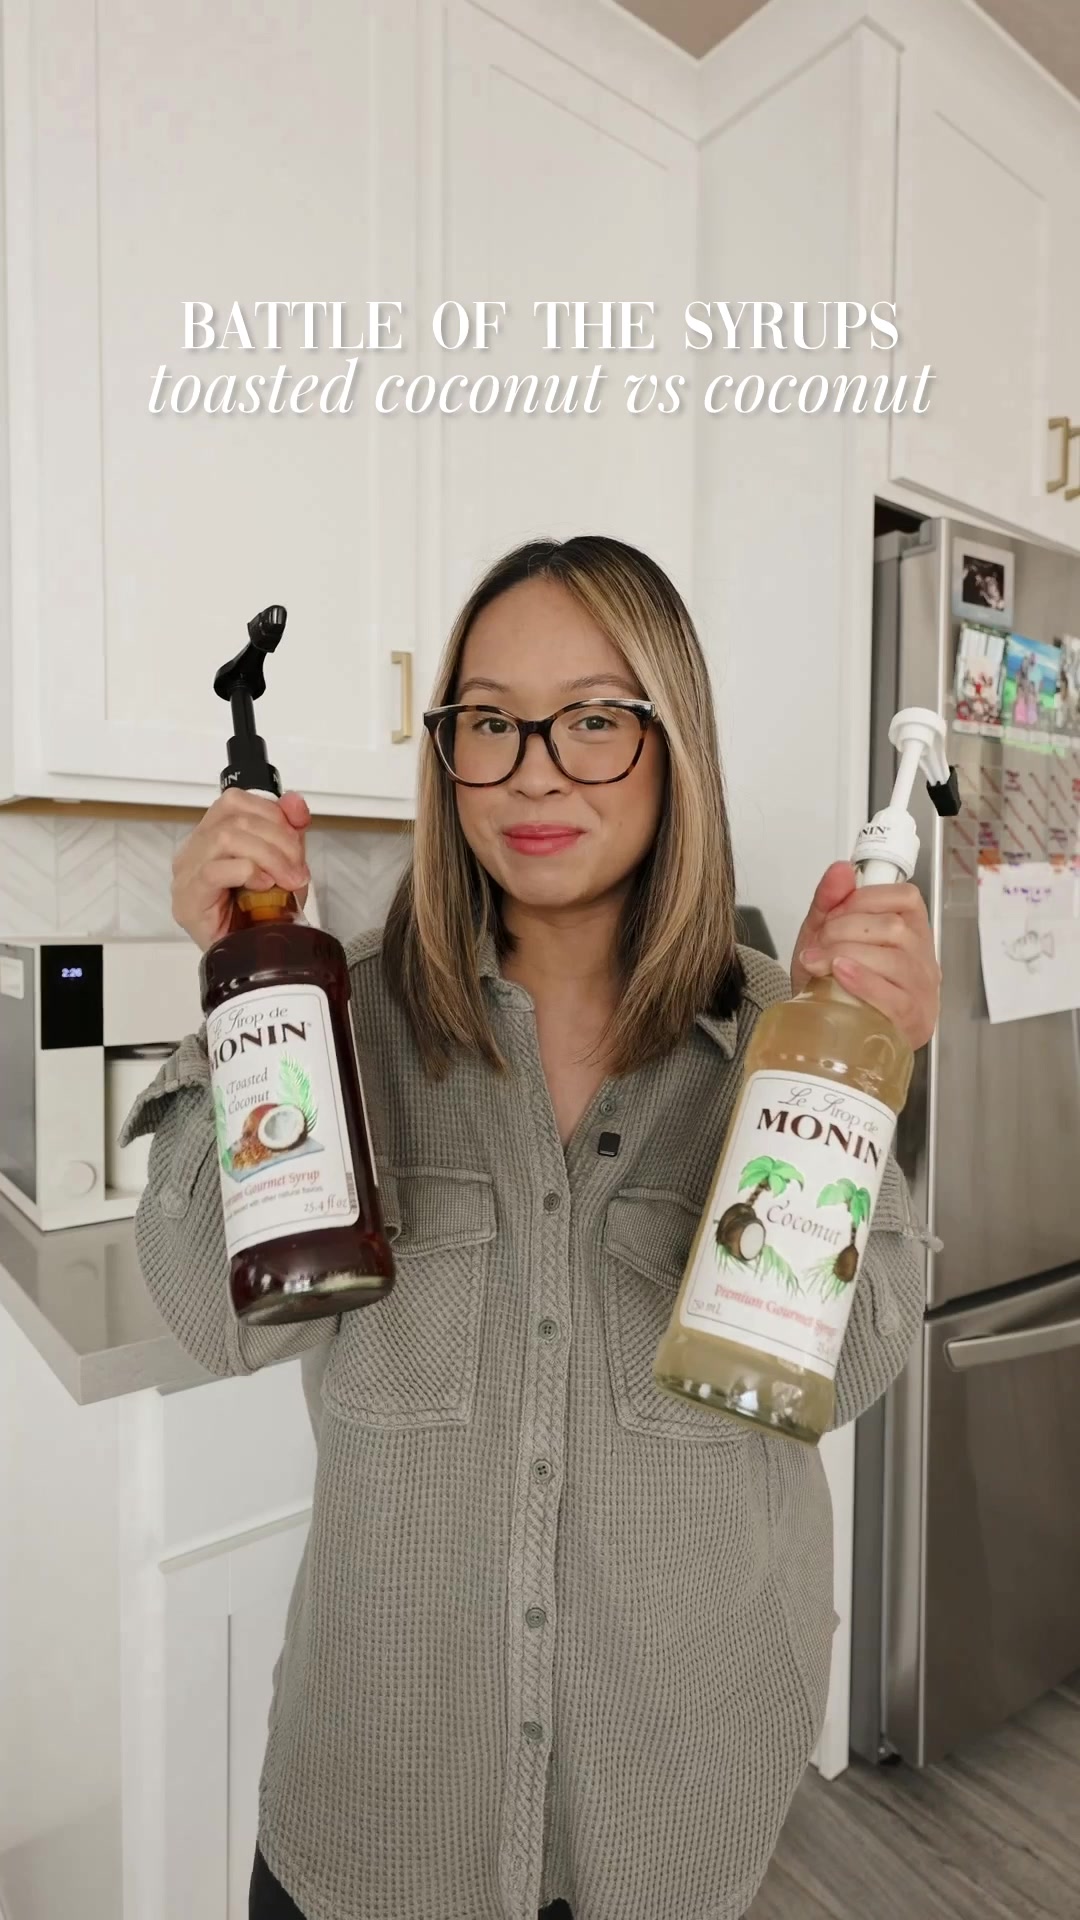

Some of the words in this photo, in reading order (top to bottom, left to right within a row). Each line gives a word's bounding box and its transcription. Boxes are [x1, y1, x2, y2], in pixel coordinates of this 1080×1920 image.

[61, 967, 83, 978] 2:26
[269, 1007, 288, 1019] de
[226, 1067, 268, 1096] Toasted
[227, 1090, 270, 1116] Coconut
[777, 1087, 813, 1108] Le
[756, 1107, 883, 1172] MONIN
[766, 1199, 843, 1247] Coconut
